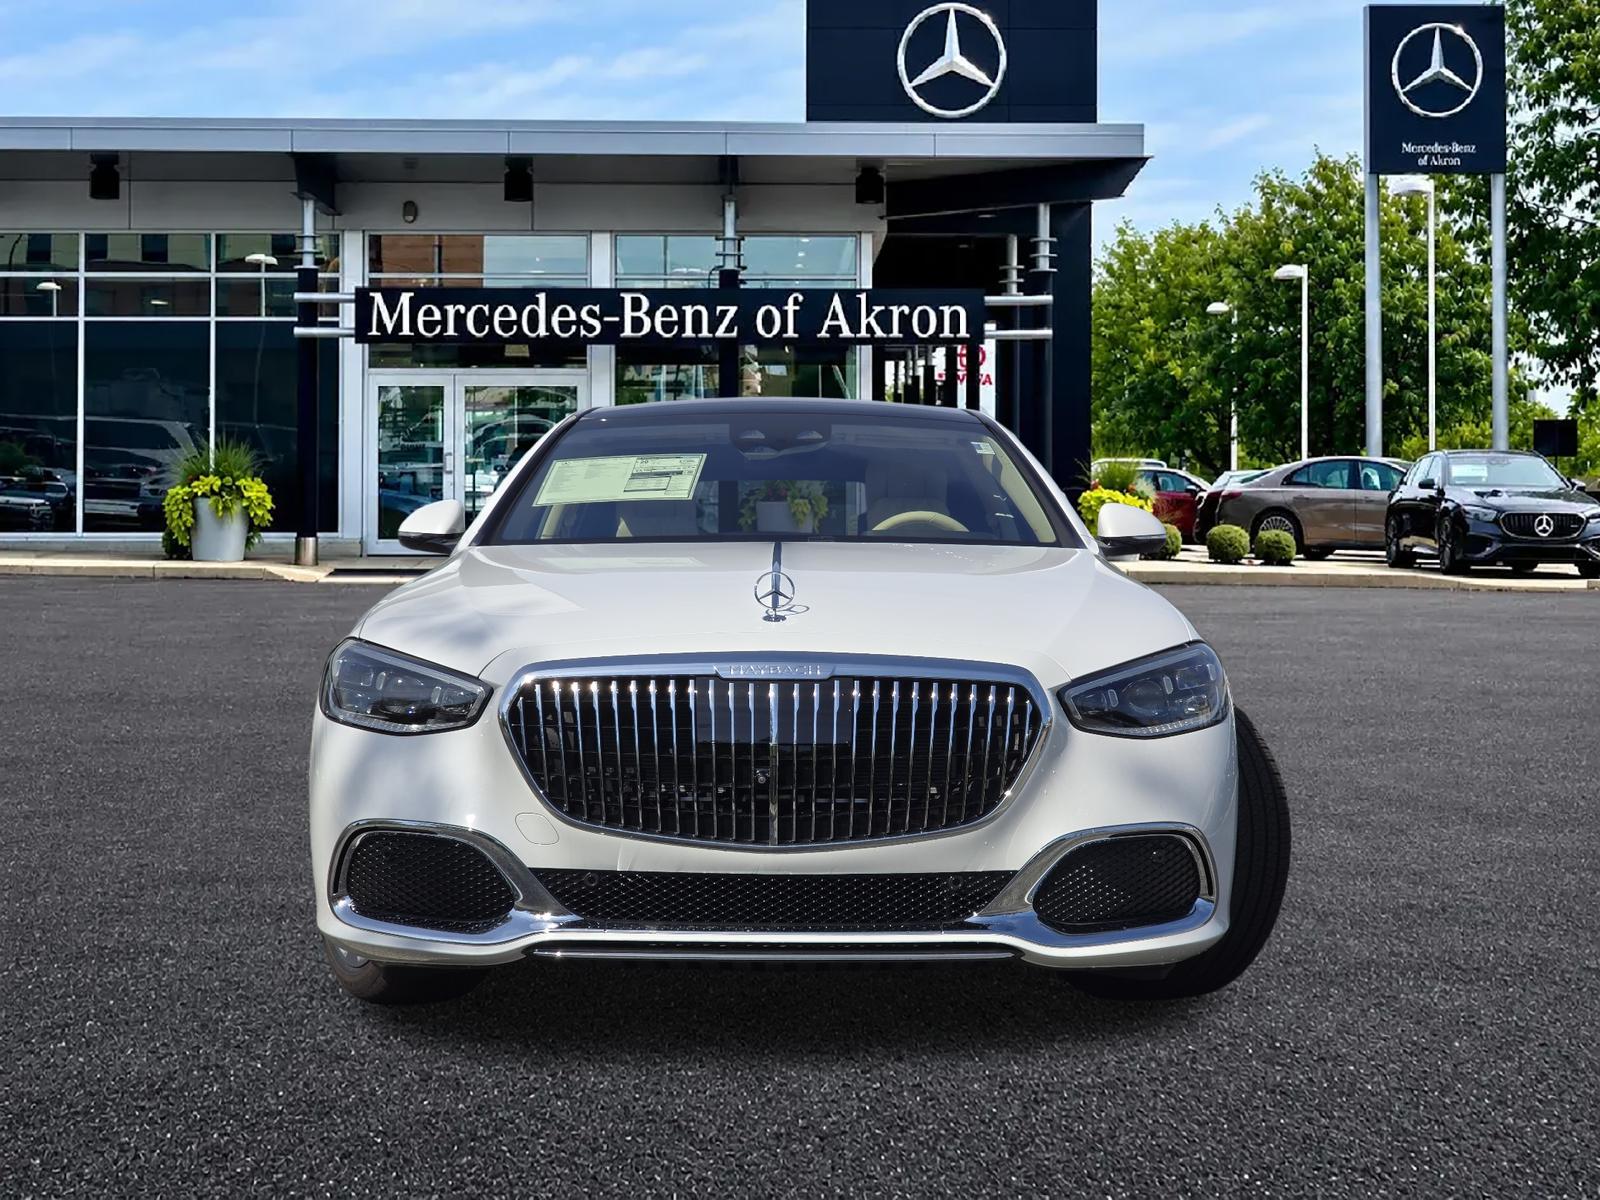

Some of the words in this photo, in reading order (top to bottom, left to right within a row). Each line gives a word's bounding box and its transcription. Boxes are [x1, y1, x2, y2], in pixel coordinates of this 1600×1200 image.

[1401, 141, 1476, 154] Mercedes-Benz
[1417, 154, 1429, 166] of
[1430, 154, 1461, 166] Akron
[367, 290, 739, 340] Mercedes-Benz
[755, 290, 803, 340] of
[816, 290, 971, 340] Akron
[729, 664, 822, 675] MAYBACH
